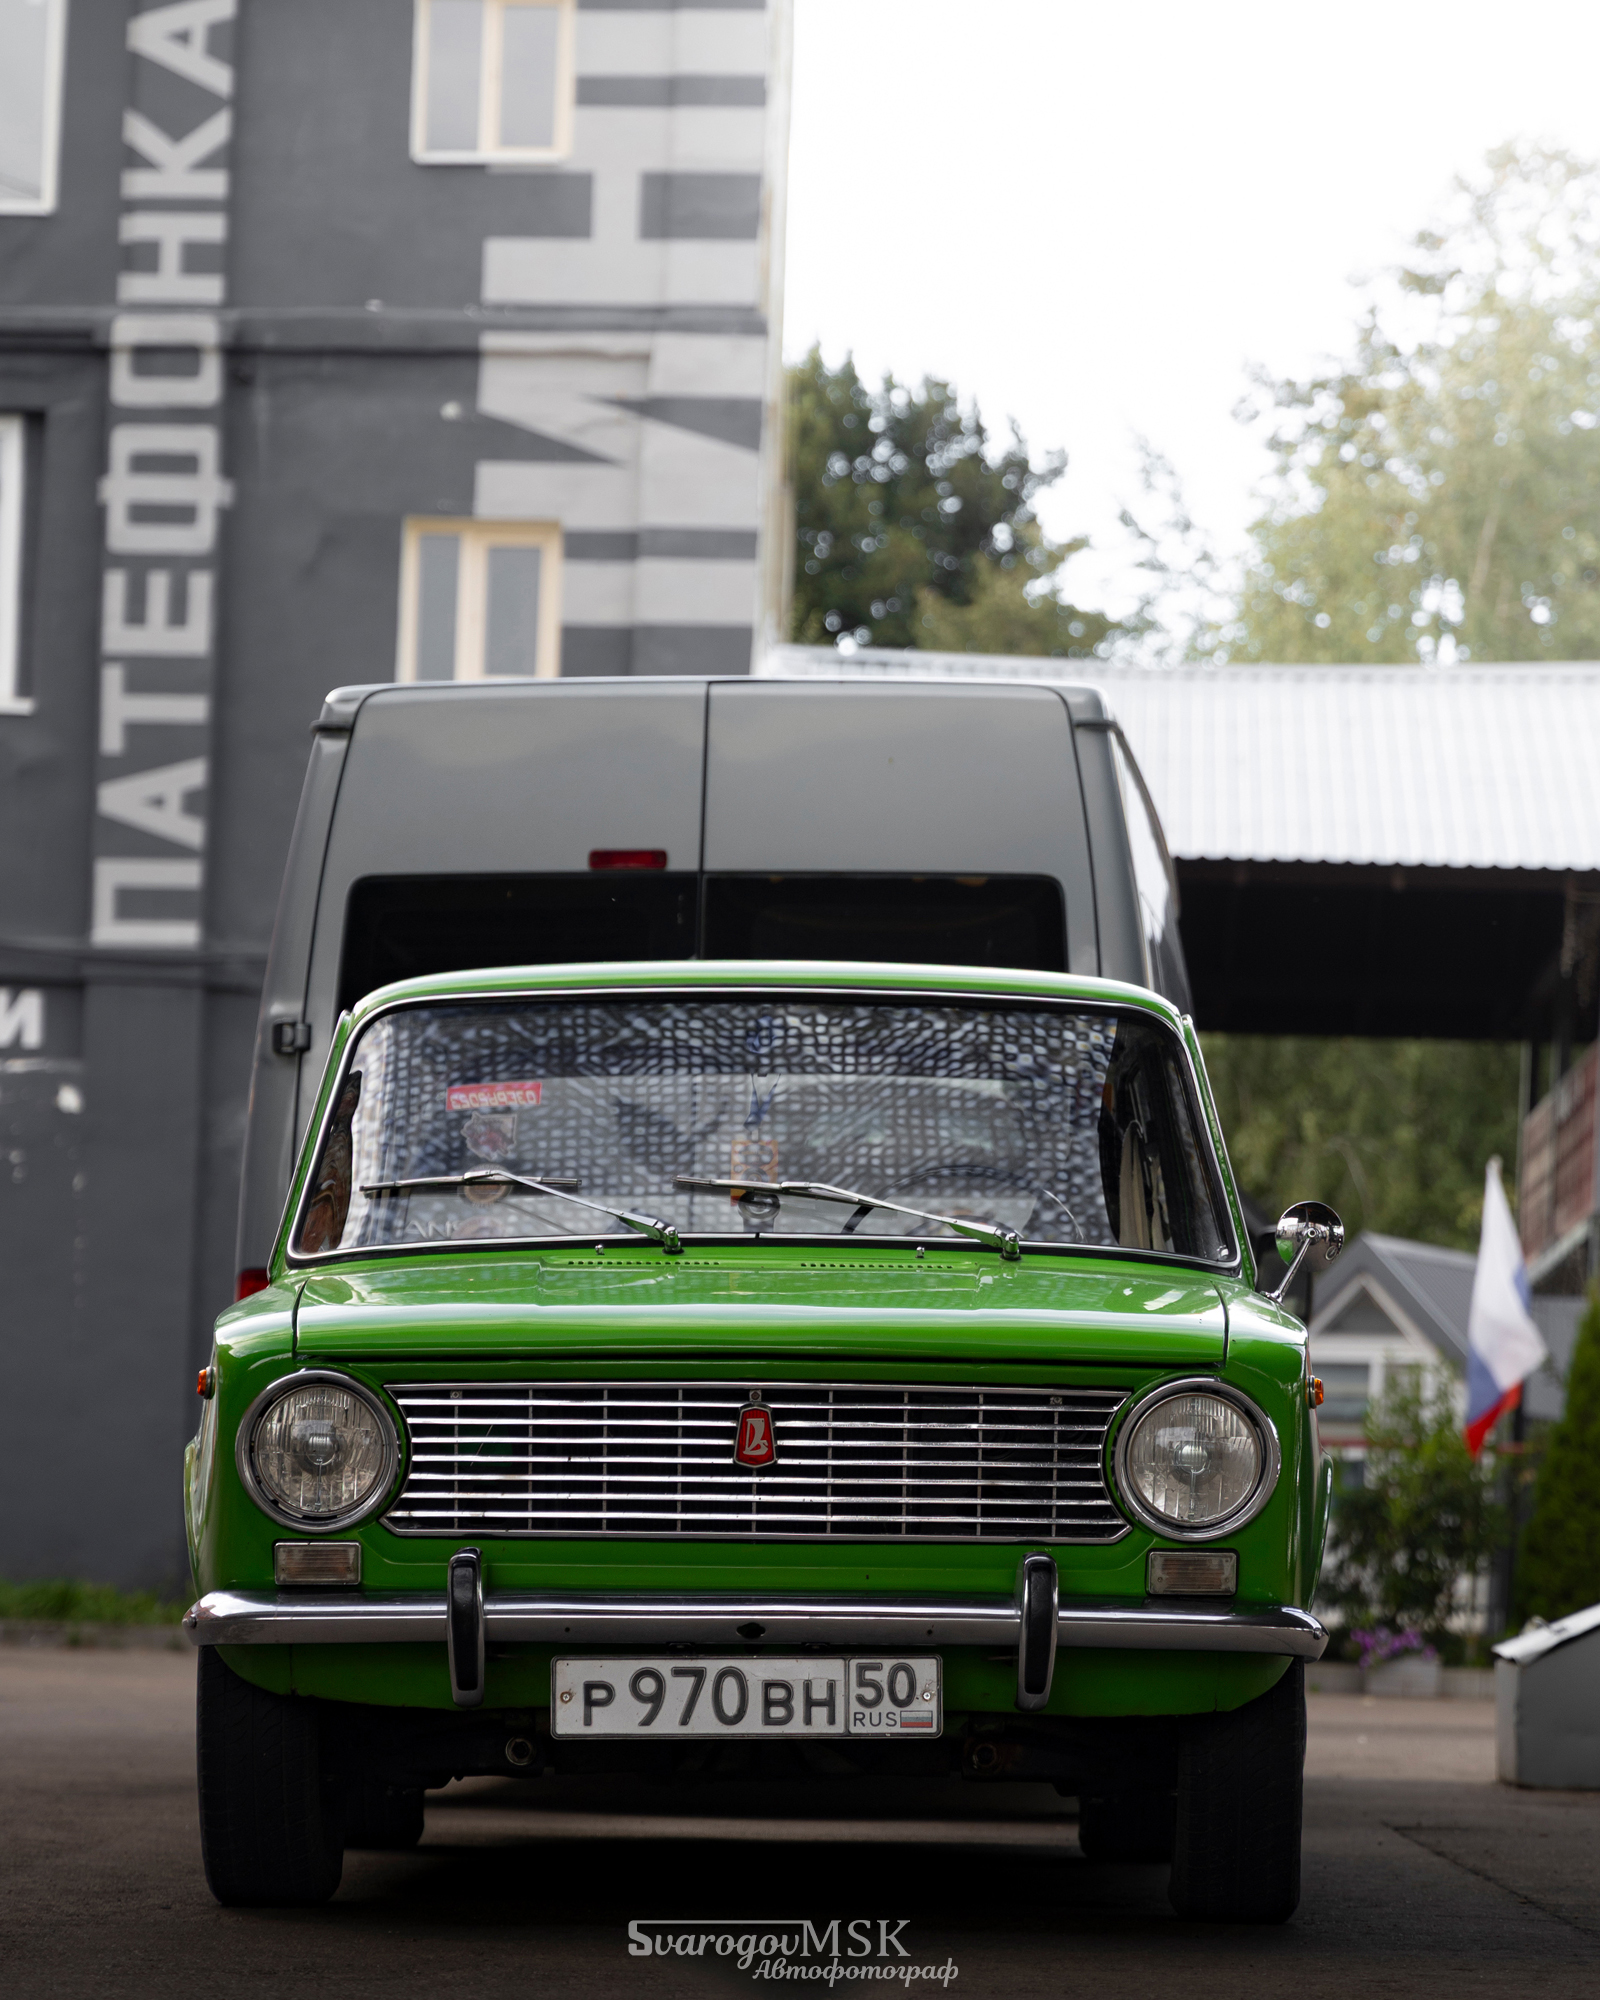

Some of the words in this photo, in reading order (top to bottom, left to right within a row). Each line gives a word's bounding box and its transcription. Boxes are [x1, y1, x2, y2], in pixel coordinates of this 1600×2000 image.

[92, 0, 238, 948] ПАТЕФОНКА
[854, 1662, 917, 1708] 50
[853, 1711, 897, 1728] RUS
